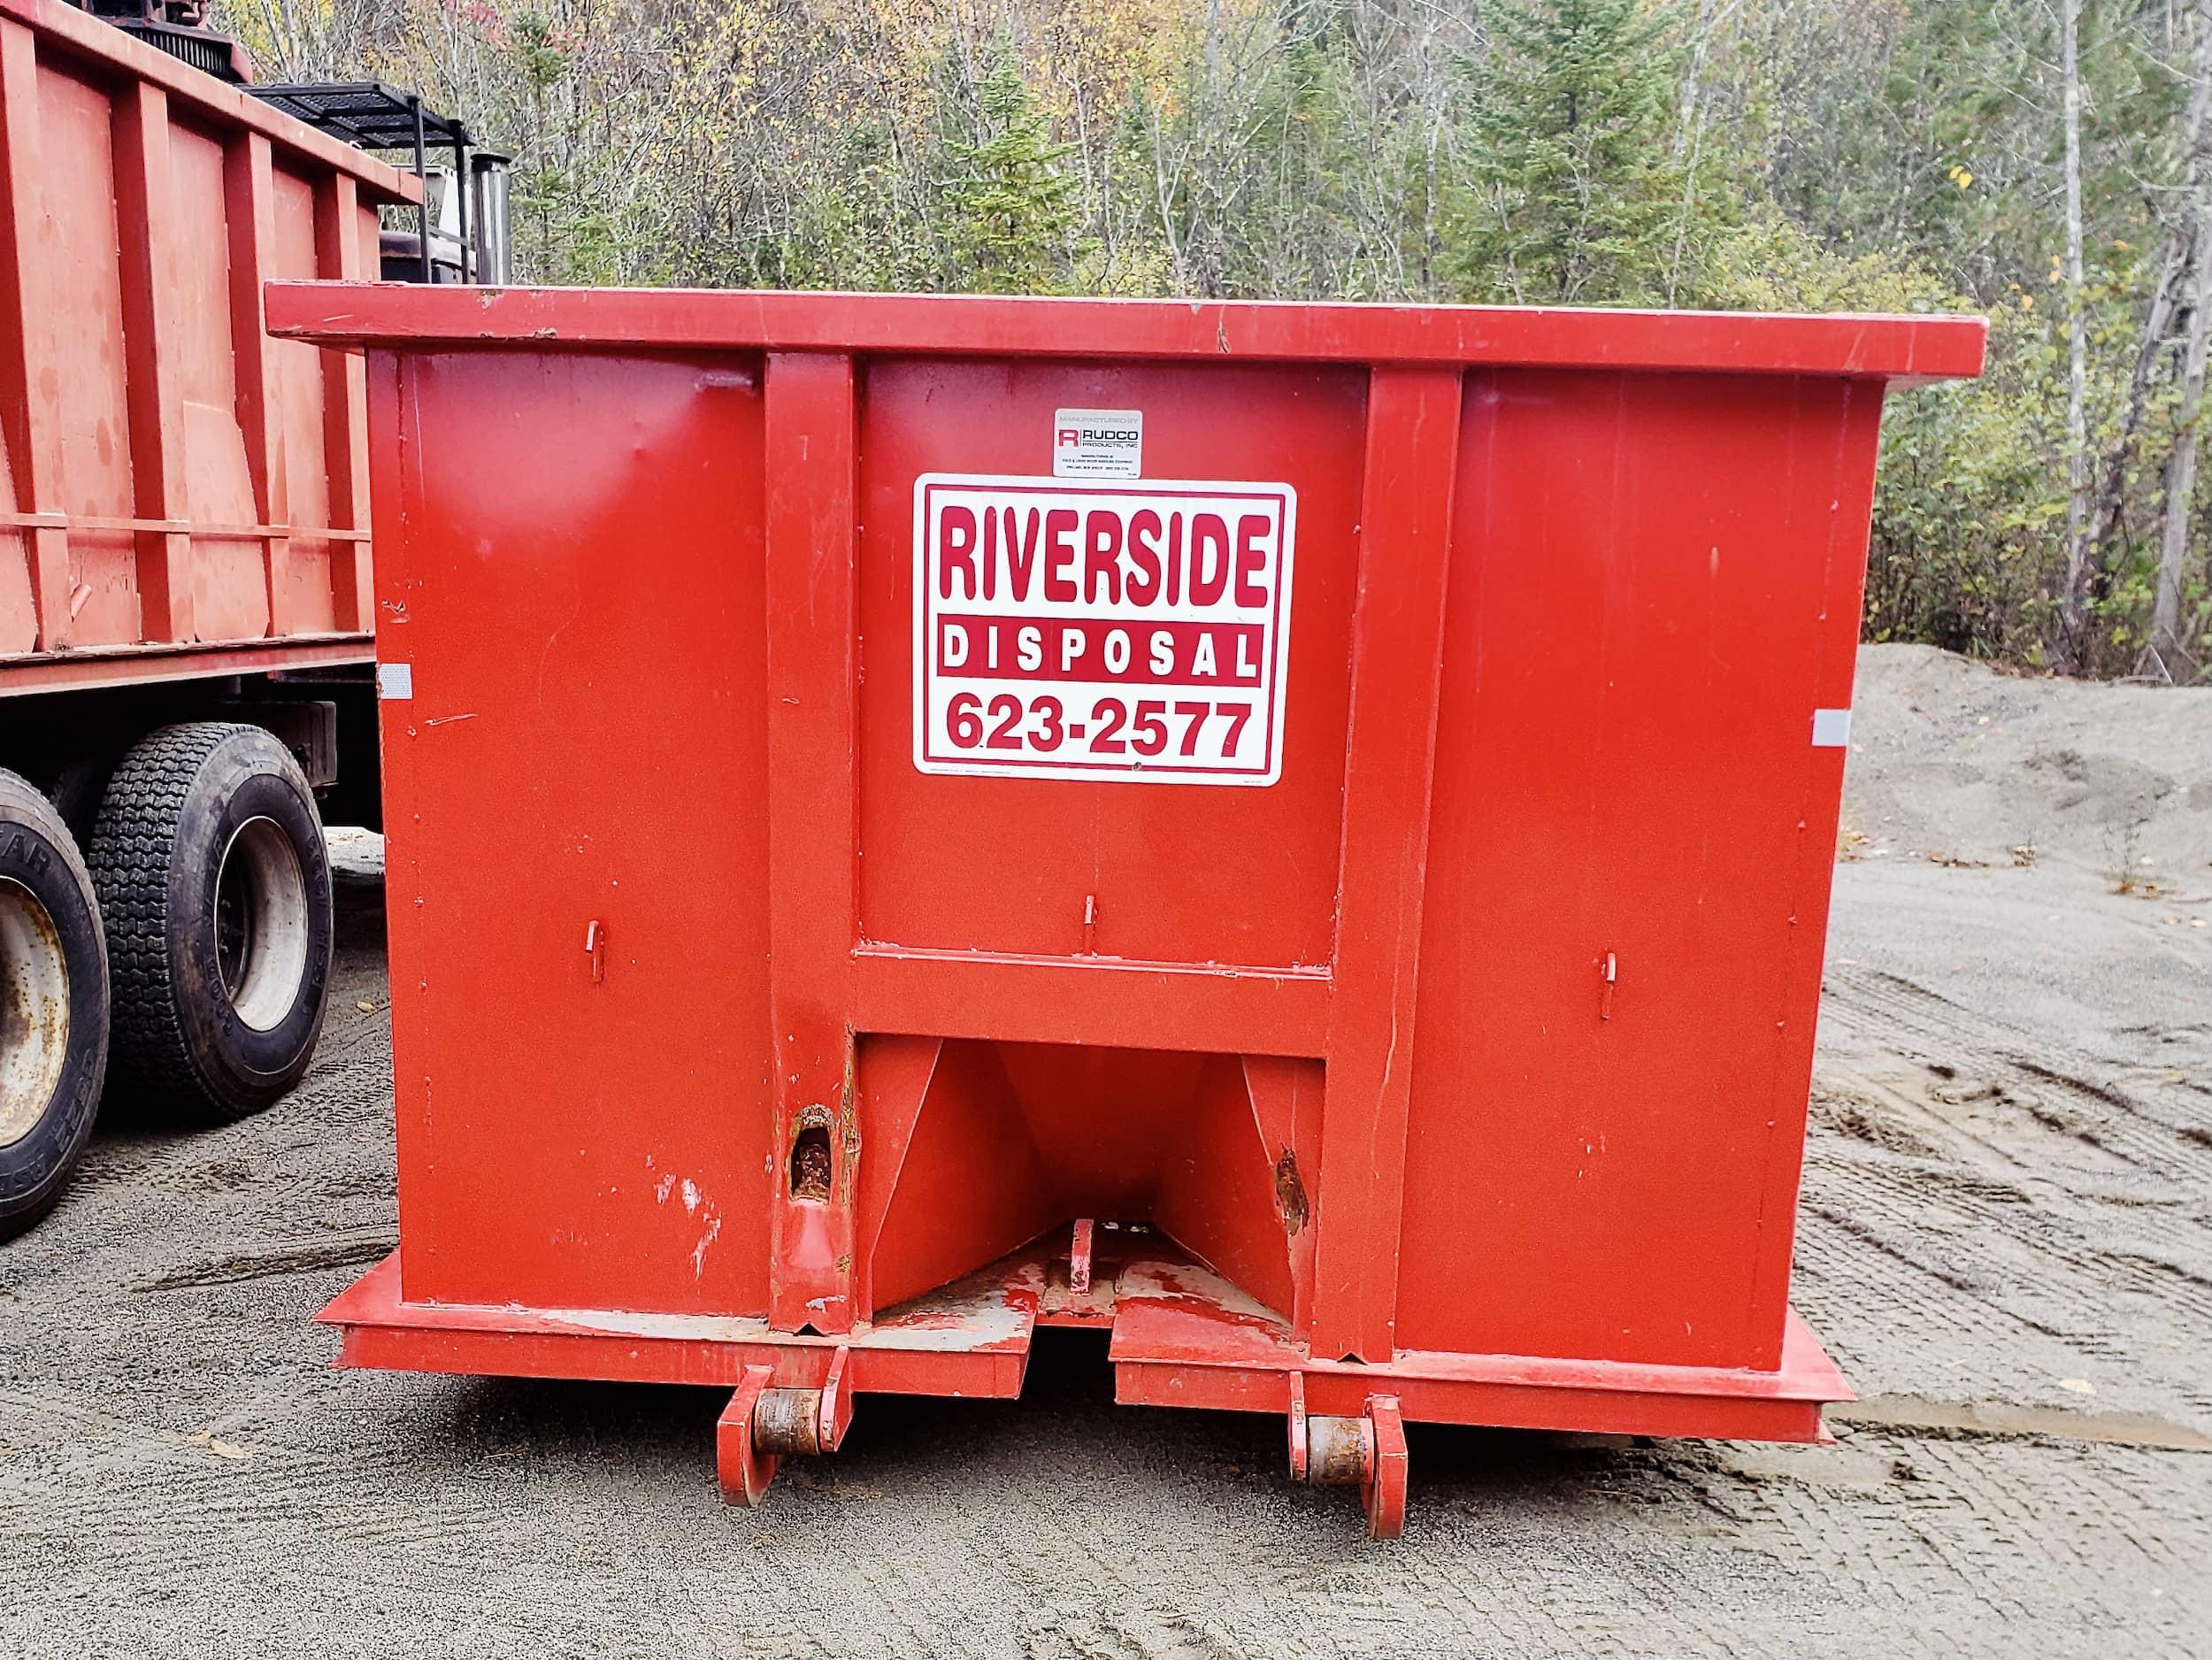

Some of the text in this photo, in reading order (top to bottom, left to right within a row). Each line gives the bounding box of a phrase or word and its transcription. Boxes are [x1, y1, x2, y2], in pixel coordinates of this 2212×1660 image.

[1059, 429, 1139, 447] R RUDCO
[939, 505, 1271, 608] RIVERSIDE
[942, 623, 1257, 679] DISPOSAL
[946, 692, 1252, 757] 623-2577
